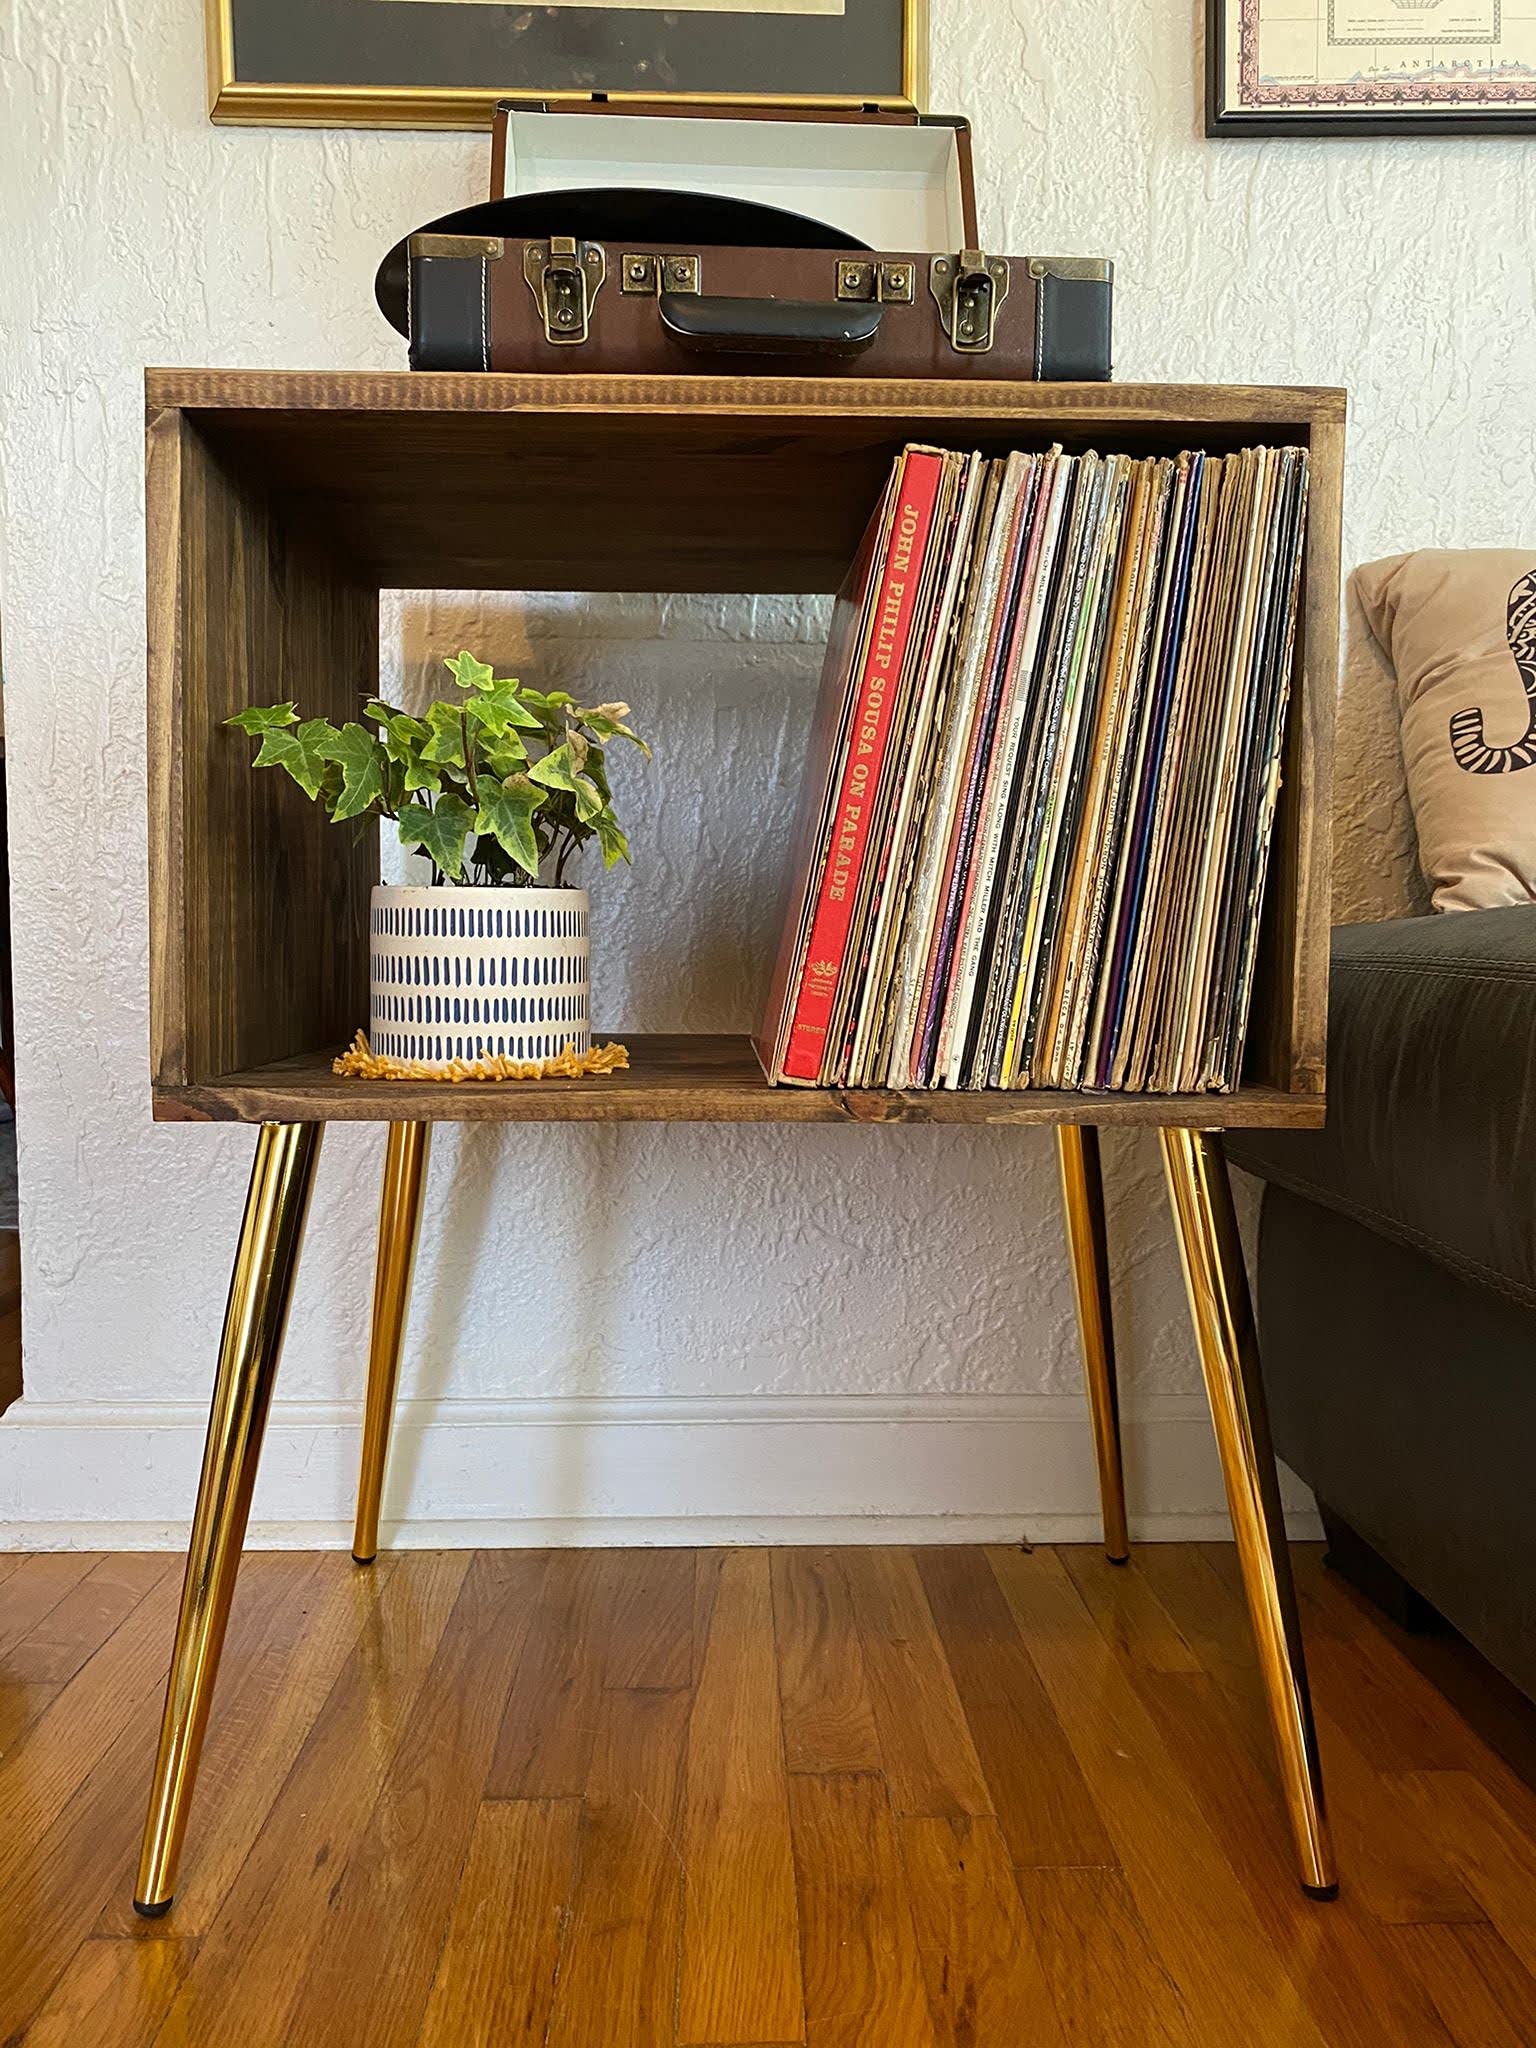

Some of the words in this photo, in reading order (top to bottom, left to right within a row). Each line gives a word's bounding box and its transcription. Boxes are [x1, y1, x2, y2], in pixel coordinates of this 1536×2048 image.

[1399, 59, 1521, 68] ANTARCTICA
[894, 505, 918, 572] JOHN
[1037, 575, 1046, 604] MILLER
[876, 581, 907, 672] PHILIP
[858, 677, 888, 759] SOUSA
[1013, 716, 1021, 738] YOUR
[1006, 742, 1016, 776] REQUEST
[850, 764, 868, 798] ON
[996, 804, 1004, 829] ALONG
[829, 804, 865, 904] PARADE
[991, 834, 999, 853] WITH
[986, 857, 995, 882] MITCH
[980, 885, 990, 913] MILLER
[968, 955, 977, 977] GANG
[1061, 989, 1069, 1017] DECCA
